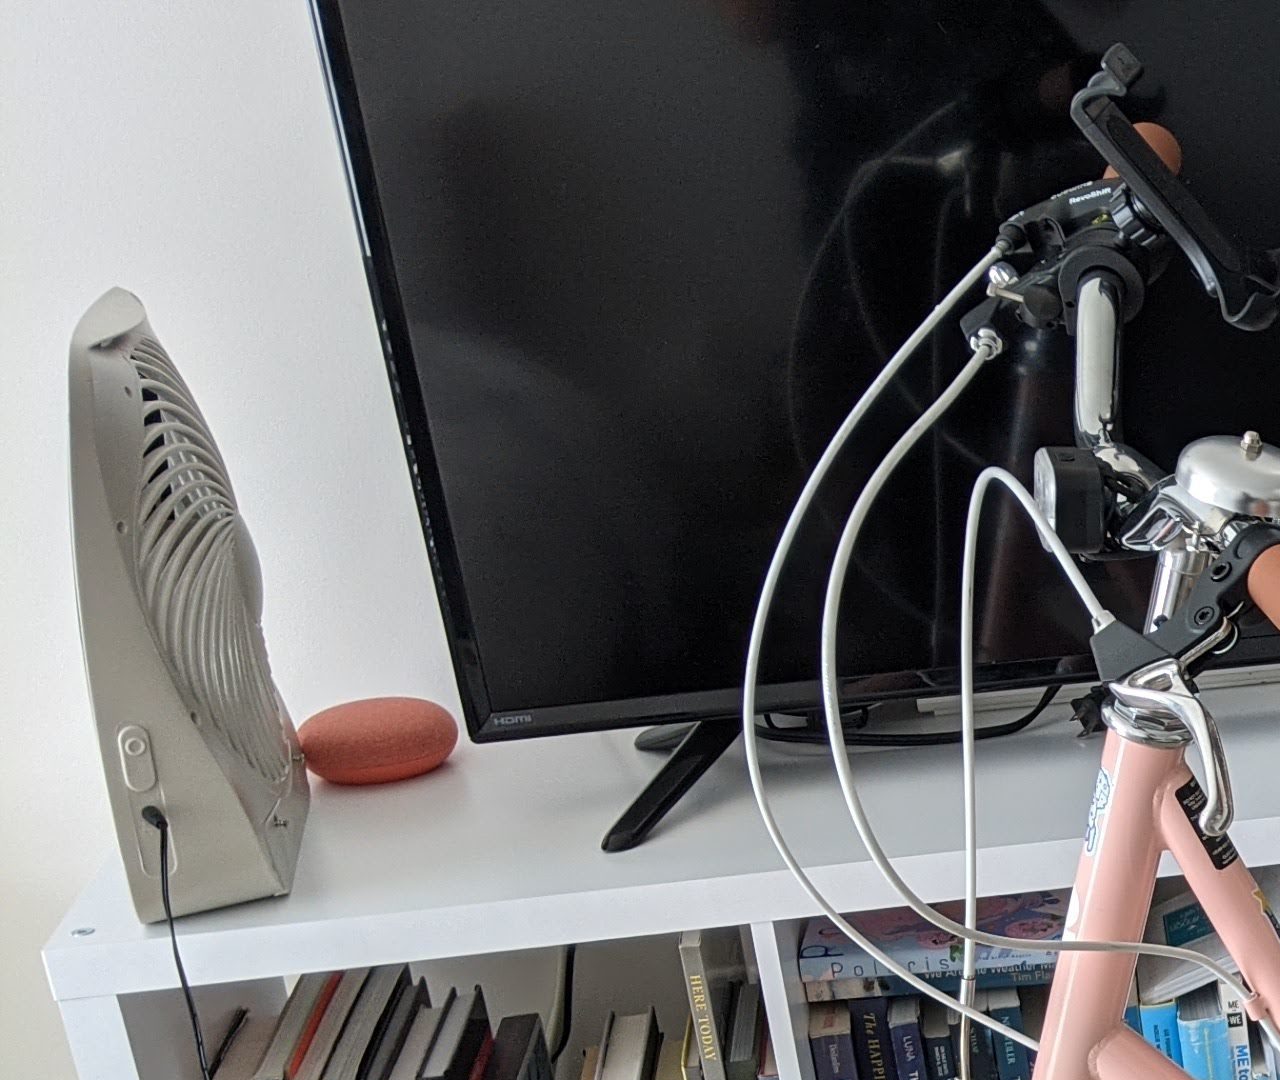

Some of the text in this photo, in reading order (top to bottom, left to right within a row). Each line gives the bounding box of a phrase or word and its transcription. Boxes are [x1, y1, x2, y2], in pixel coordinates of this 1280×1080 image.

[830, 954, 949, 979] Polris
[1011, 972, 1029, 982] Tim
[689, 975, 718, 1061] HERE TODAY
[863, 1012, 877, 1034] The
[1229, 1015, 1242, 1025] WE
[902, 1035, 916, 1062] LUNA
[1235, 1044, 1250, 1068] ME
